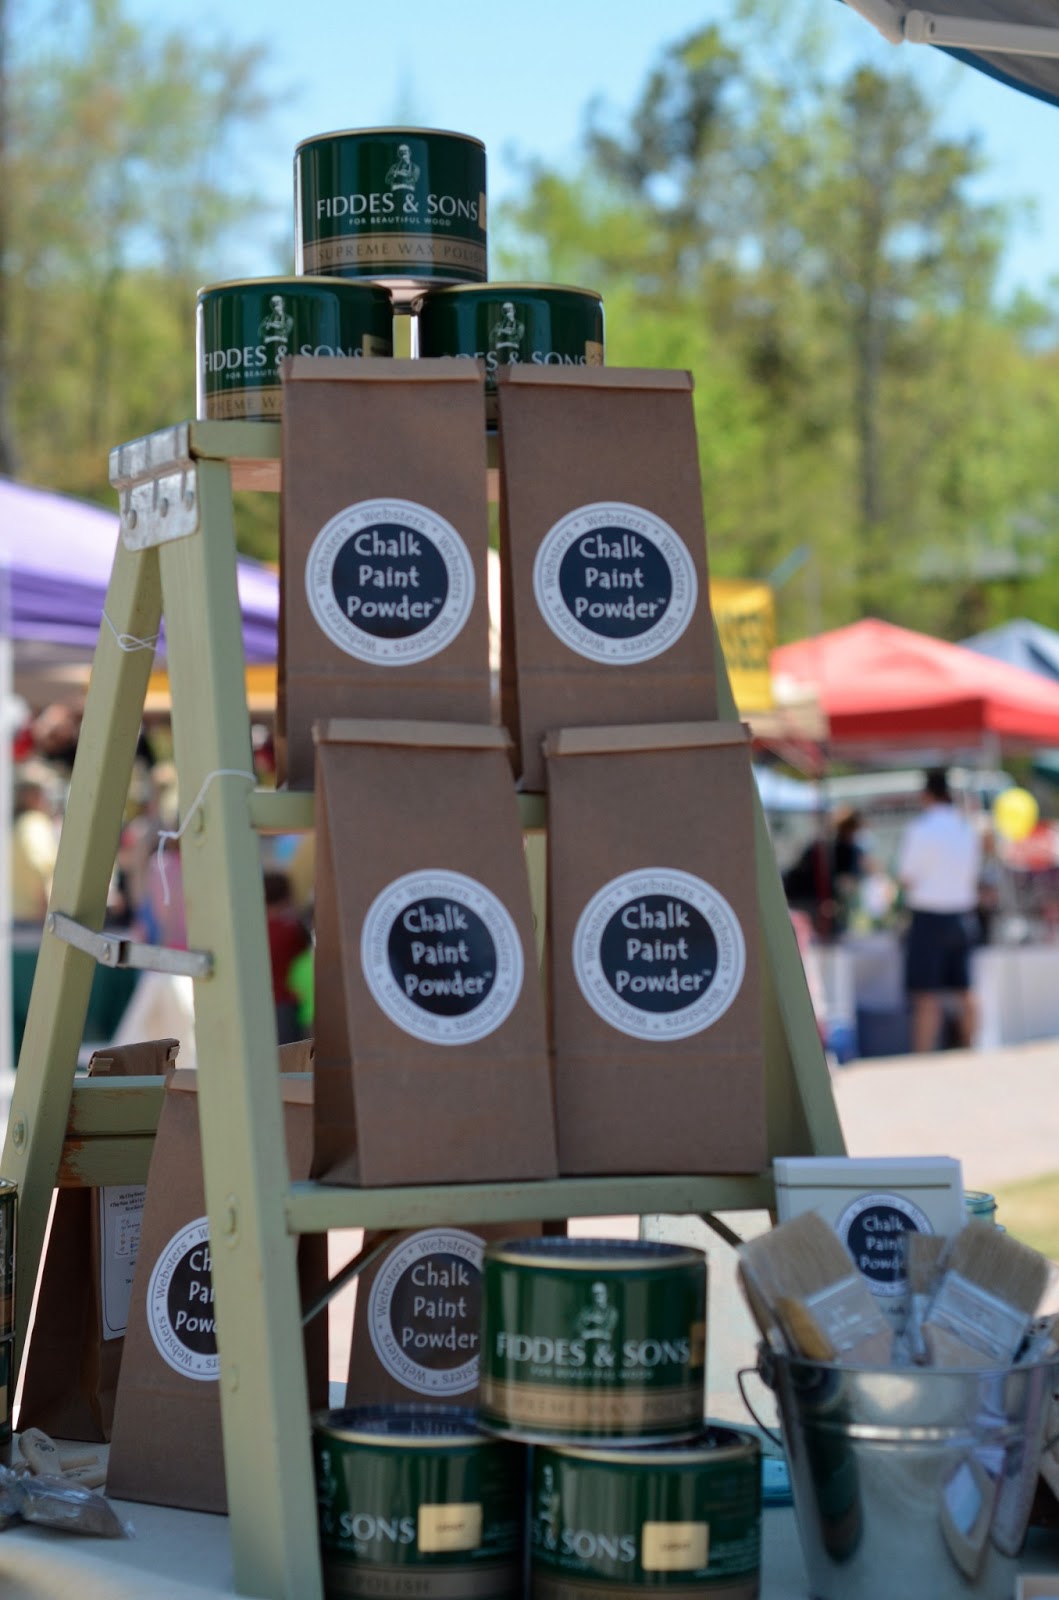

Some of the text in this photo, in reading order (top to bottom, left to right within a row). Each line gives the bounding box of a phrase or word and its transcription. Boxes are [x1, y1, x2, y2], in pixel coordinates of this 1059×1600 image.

[316, 192, 478, 221] FIDDES & SONS
[349, 216, 451, 227] FOR BEAUTIFUL WOOD
[319, 243, 389, 262] SUPREME
[398, 243, 435, 255] WAX
[354, 530, 422, 558] Chalk
[579, 534, 645, 560] Chalk
[359, 565, 420, 589] Paint
[585, 567, 645, 589] Paint
[403, 904, 469, 933] Chalk
[621, 902, 690, 930] Chalk
[411, 940, 470, 965] Paint
[627, 937, 689, 962] Paint
[862, 1214, 905, 1232] Chalk
[420, 1238, 477, 1259] Websters
[156, 1242, 188, 1300] Websters
[411, 1261, 470, 1288] Chalk
[860, 1255, 902, 1270] Powd
[377, 1257, 408, 1318] Websters
[413, 1295, 468, 1319] Paint
[175, 1310, 218, 1333] Pow
[158, 1316, 193, 1367] Websters
[402, 1326, 479, 1351] Powder
[496, 1332, 690, 1368] FIDDES & SONS
[382, 1334, 427, 1384] Websters
[340, 1512, 415, 1544] SONS
[561, 1528, 636, 1562] SONS
